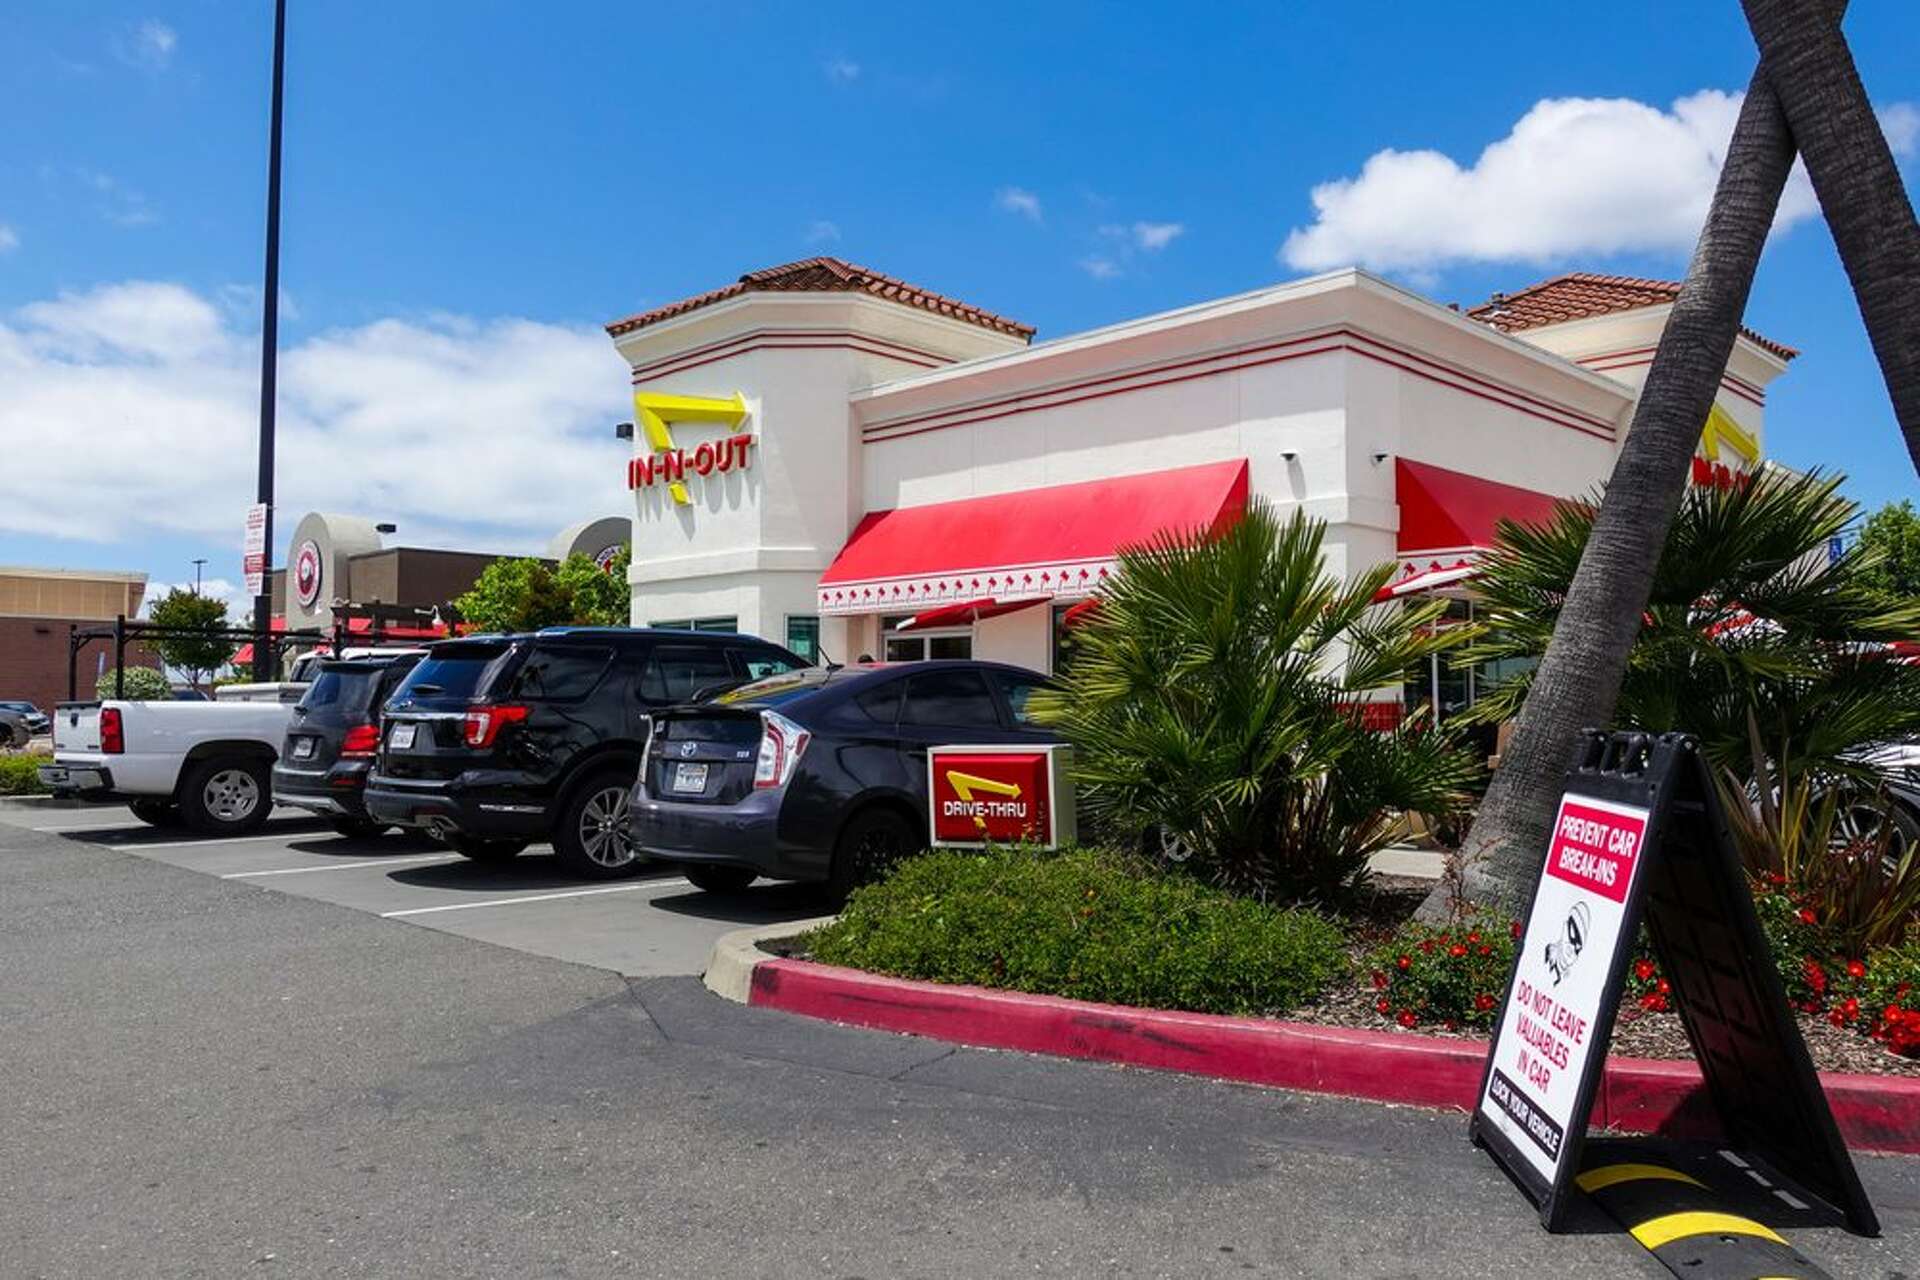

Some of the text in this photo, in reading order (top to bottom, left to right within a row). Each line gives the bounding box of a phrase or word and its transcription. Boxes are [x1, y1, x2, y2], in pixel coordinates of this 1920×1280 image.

[628, 433, 753, 490] IN-N-OUT
[943, 800, 1027, 818] DRIVE-THRU
[1559, 815, 1637, 858] PREVENT CAR
[1559, 845, 1618, 887] BREAK-INS
[1517, 980, 1587, 1046] DO NOT LEAVE
[1516, 1012, 1570, 1071] VALUABLES
[1517, 1048, 1551, 1094] IN CAR
[1491, 1076, 1560, 1153] LOCK YOUR VEHICLE
